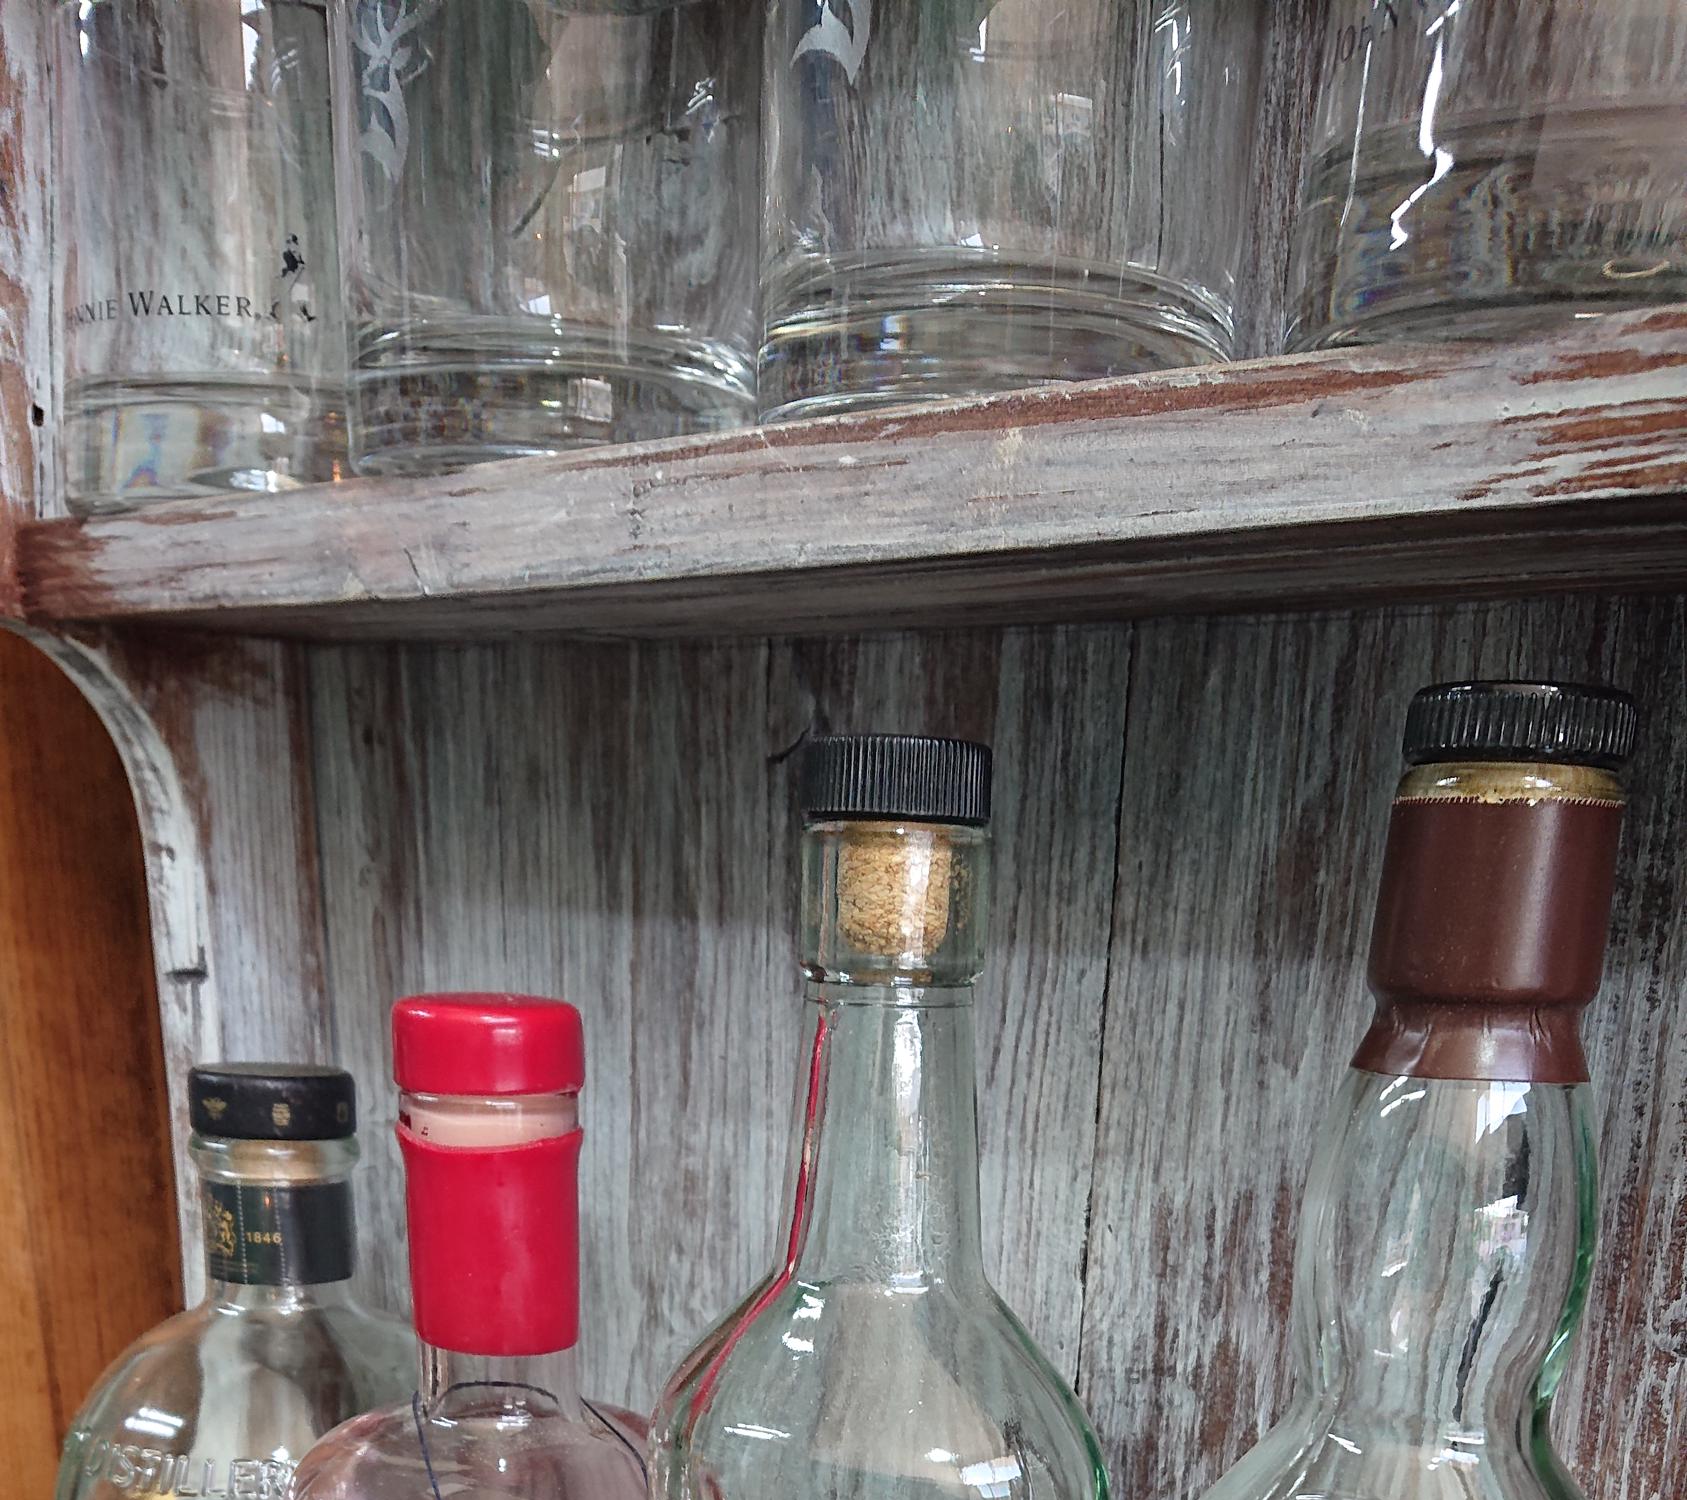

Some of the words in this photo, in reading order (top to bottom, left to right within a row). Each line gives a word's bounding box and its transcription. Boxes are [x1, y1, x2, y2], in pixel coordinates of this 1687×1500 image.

[68, 299, 117, 325] NNIE
[128, 290, 253, 318] WALKER
[246, 1231, 283, 1245] 1846
